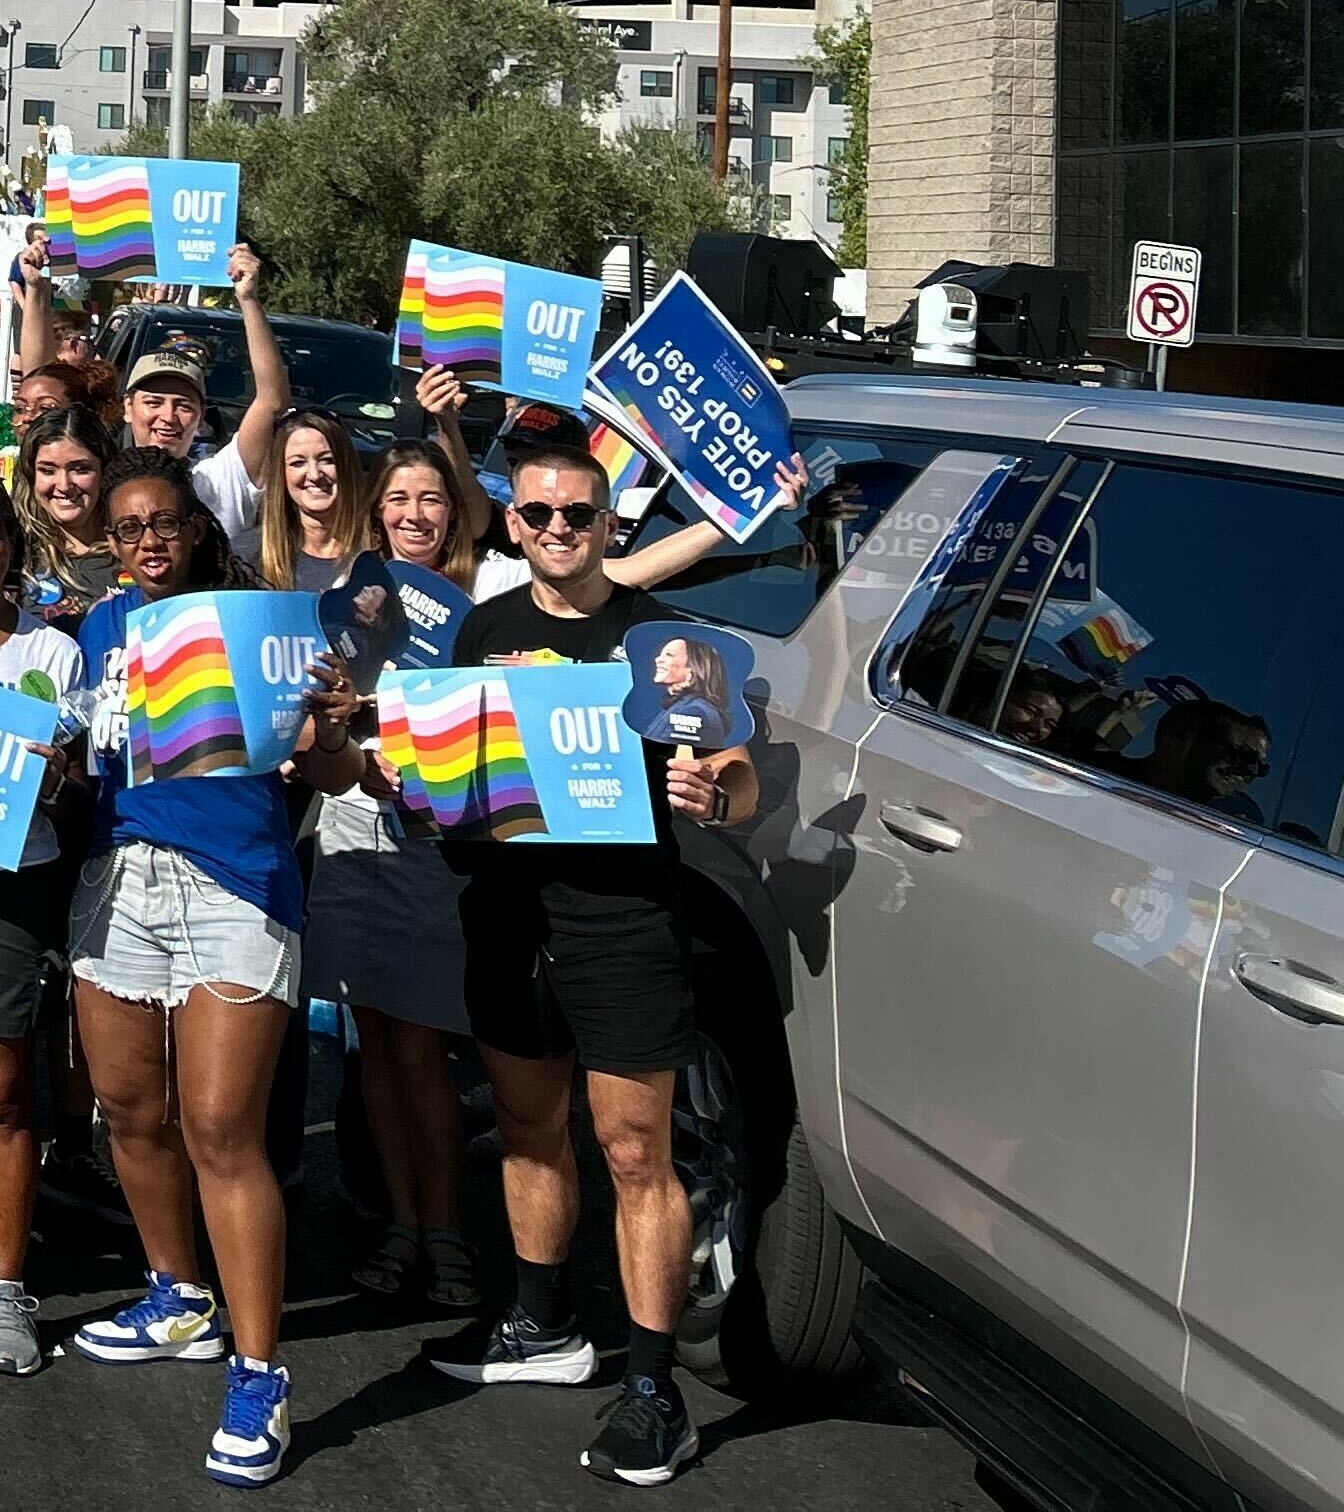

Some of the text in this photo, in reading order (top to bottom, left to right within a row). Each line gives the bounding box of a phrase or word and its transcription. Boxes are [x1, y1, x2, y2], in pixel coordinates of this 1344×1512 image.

[173, 189, 226, 224] OUT
[1140, 252, 1194, 273] BEGINS
[527, 300, 586, 343] OUT
[527, 352, 569, 373] HARRIS
[655, 340, 772, 469] PROP 139!
[618, 342, 766, 510] VOTE YES ON
[398, 583, 451, 625] HARRIS
[261, 636, 317, 685] OUT
[550, 706, 621, 754] OUT
[568, 778, 623, 797] HARRIS
[577, 797, 616, 808] WALZ
